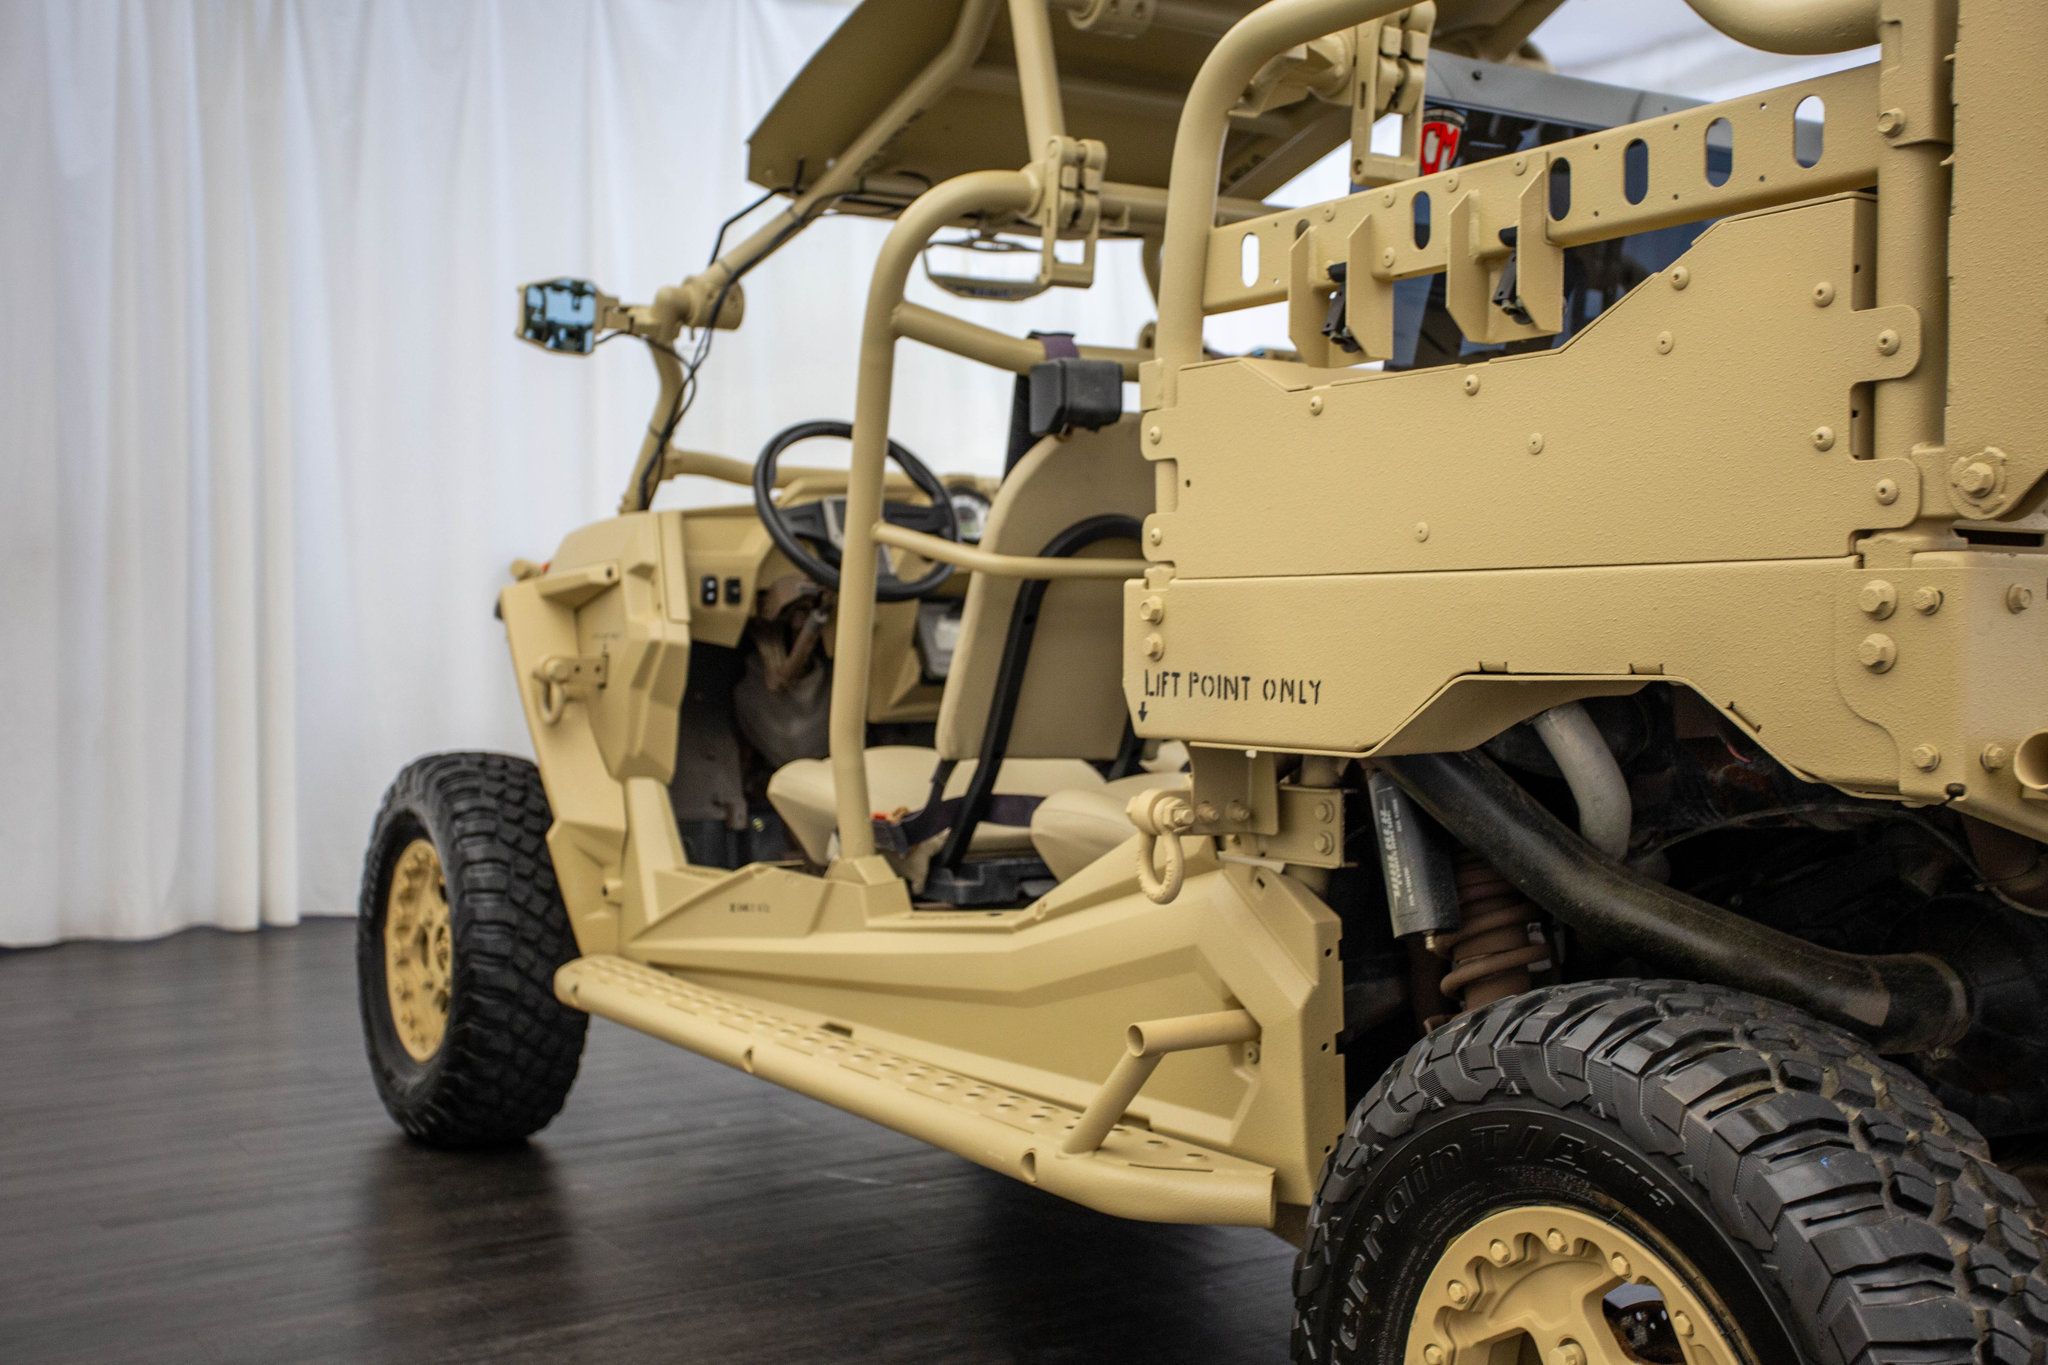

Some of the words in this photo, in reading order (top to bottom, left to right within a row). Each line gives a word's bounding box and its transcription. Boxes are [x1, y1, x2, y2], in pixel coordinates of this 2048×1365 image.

[1144, 669, 1181, 698] LIFT
[1188, 671, 1251, 701] POINT
[1262, 677, 1322, 705] ONLY
